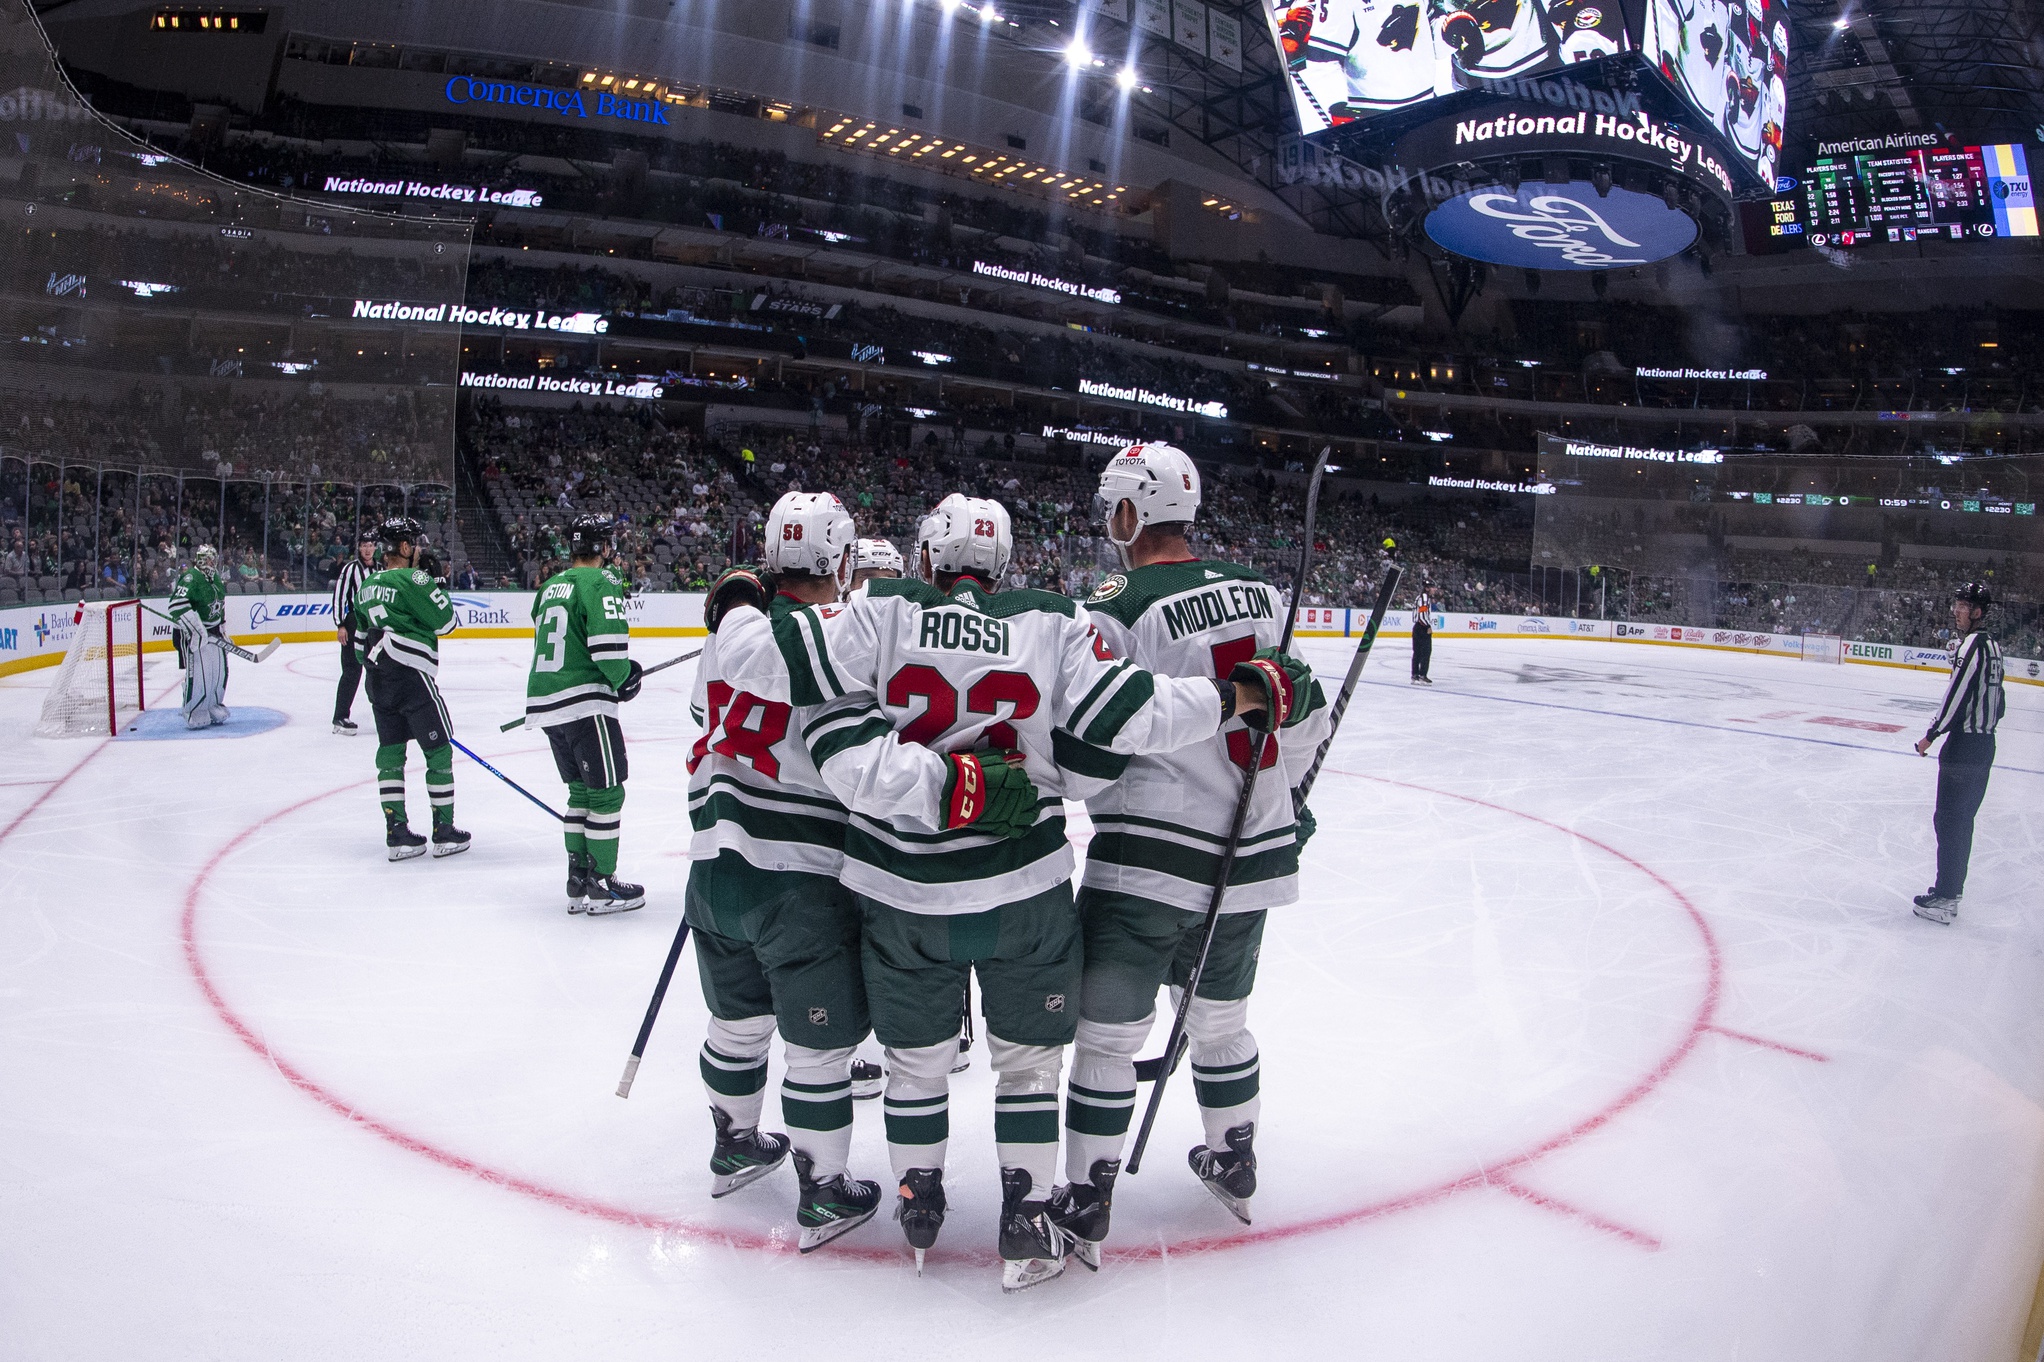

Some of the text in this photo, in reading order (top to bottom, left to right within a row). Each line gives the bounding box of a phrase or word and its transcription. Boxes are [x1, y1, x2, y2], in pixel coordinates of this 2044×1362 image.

[597, 92, 671, 125] Bank
[1454, 112, 1586, 146] National
[1596, 114, 1692, 161] Hockey
[1818, 132, 1938, 155] American Airlines
[324, 177, 404, 195] National
[405, 181, 477, 202] Hockey
[2010, 182, 2028, 191] TXU
[1770, 200, 1796, 212] TEXAS
[1775, 213, 1795, 223] FORD
[1469, 194, 1648, 267] Ford
[1770, 223, 1803, 236] DEALERS
[973, 260, 1030, 284] National
[1031, 273, 1078, 295] Hockey
[352, 300, 609, 334] National Hockey Leae
[768, 301, 823, 315] STARS
[1636, 367, 1683, 379] National
[1685, 368, 1728, 381] Hockey
[460, 372, 534, 390] National
[537, 376, 602, 396] Hockey
[1079, 379, 1228, 419] National Hockey Leae
[1042, 425, 1092, 443] Nonal
[1115, 458, 1147, 467] TOYOTA
[1565, 443, 1724, 464] National Hockey Leae
[1182, 473, 1192, 490] 5
[1428, 476, 1474, 489] National
[1476, 478, 1516, 493] Hockey
[1840, 496, 1849, 505] 0
[1878, 498, 1908, 506] 10:59
[1941, 500, 1951, 510] 0
[573, 532, 581, 541] 53
[782, 523, 803, 541] 58
[974, 518, 995, 537] 23
[429, 588, 449, 610] 5
[468, 608, 510, 625] Bank
[1161, 584, 1274, 641] MIDDLEON
[51, 613, 76, 632] Baylo
[153, 625, 172, 636] NHL
[1578, 623, 1595, 633] AT&T
[918, 611, 1010, 657] ROSSI
[960, 754, 977, 820] CCM
